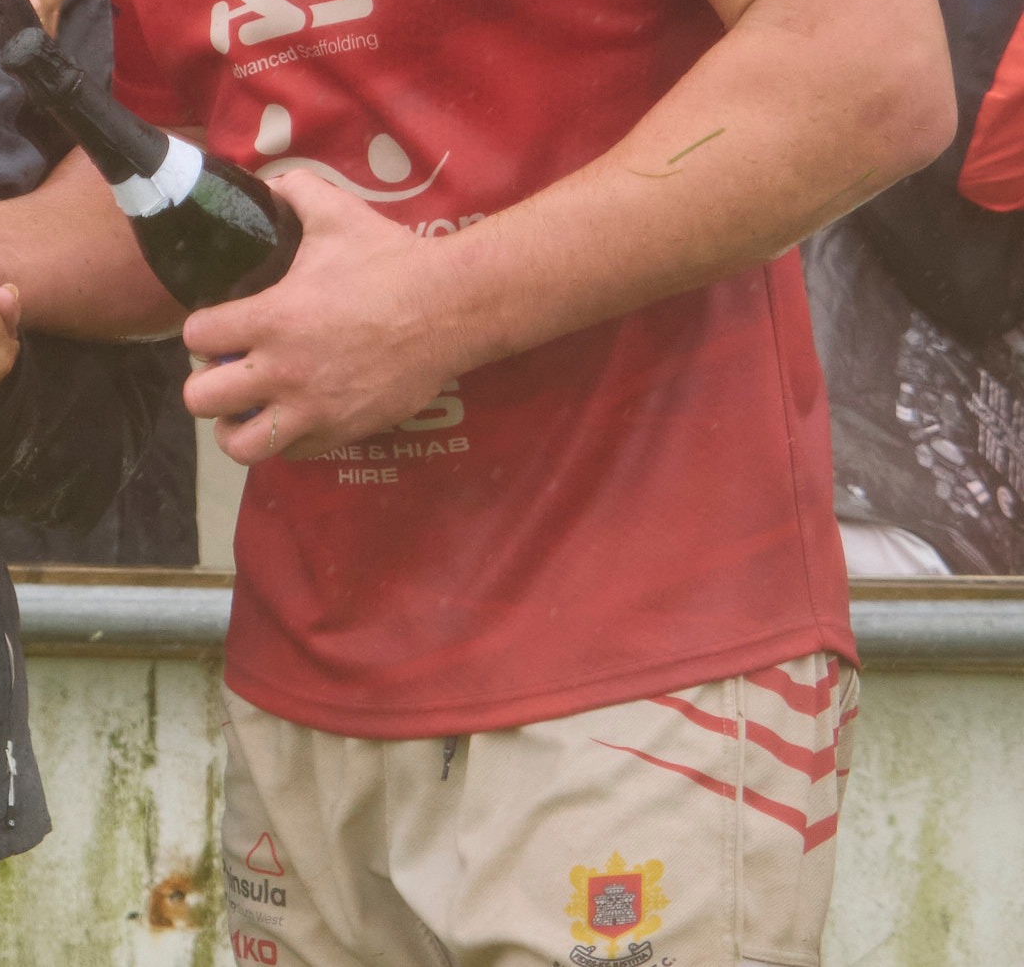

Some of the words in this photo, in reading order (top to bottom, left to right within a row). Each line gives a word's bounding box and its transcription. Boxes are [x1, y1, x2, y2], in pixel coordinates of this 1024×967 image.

[297, 33, 379, 60] Scaffolding
[310, 445, 364, 461] ANE
[368, 445, 387, 460] &
[393, 437, 471, 459] HIAB
[338, 467, 399, 484] HIRE
